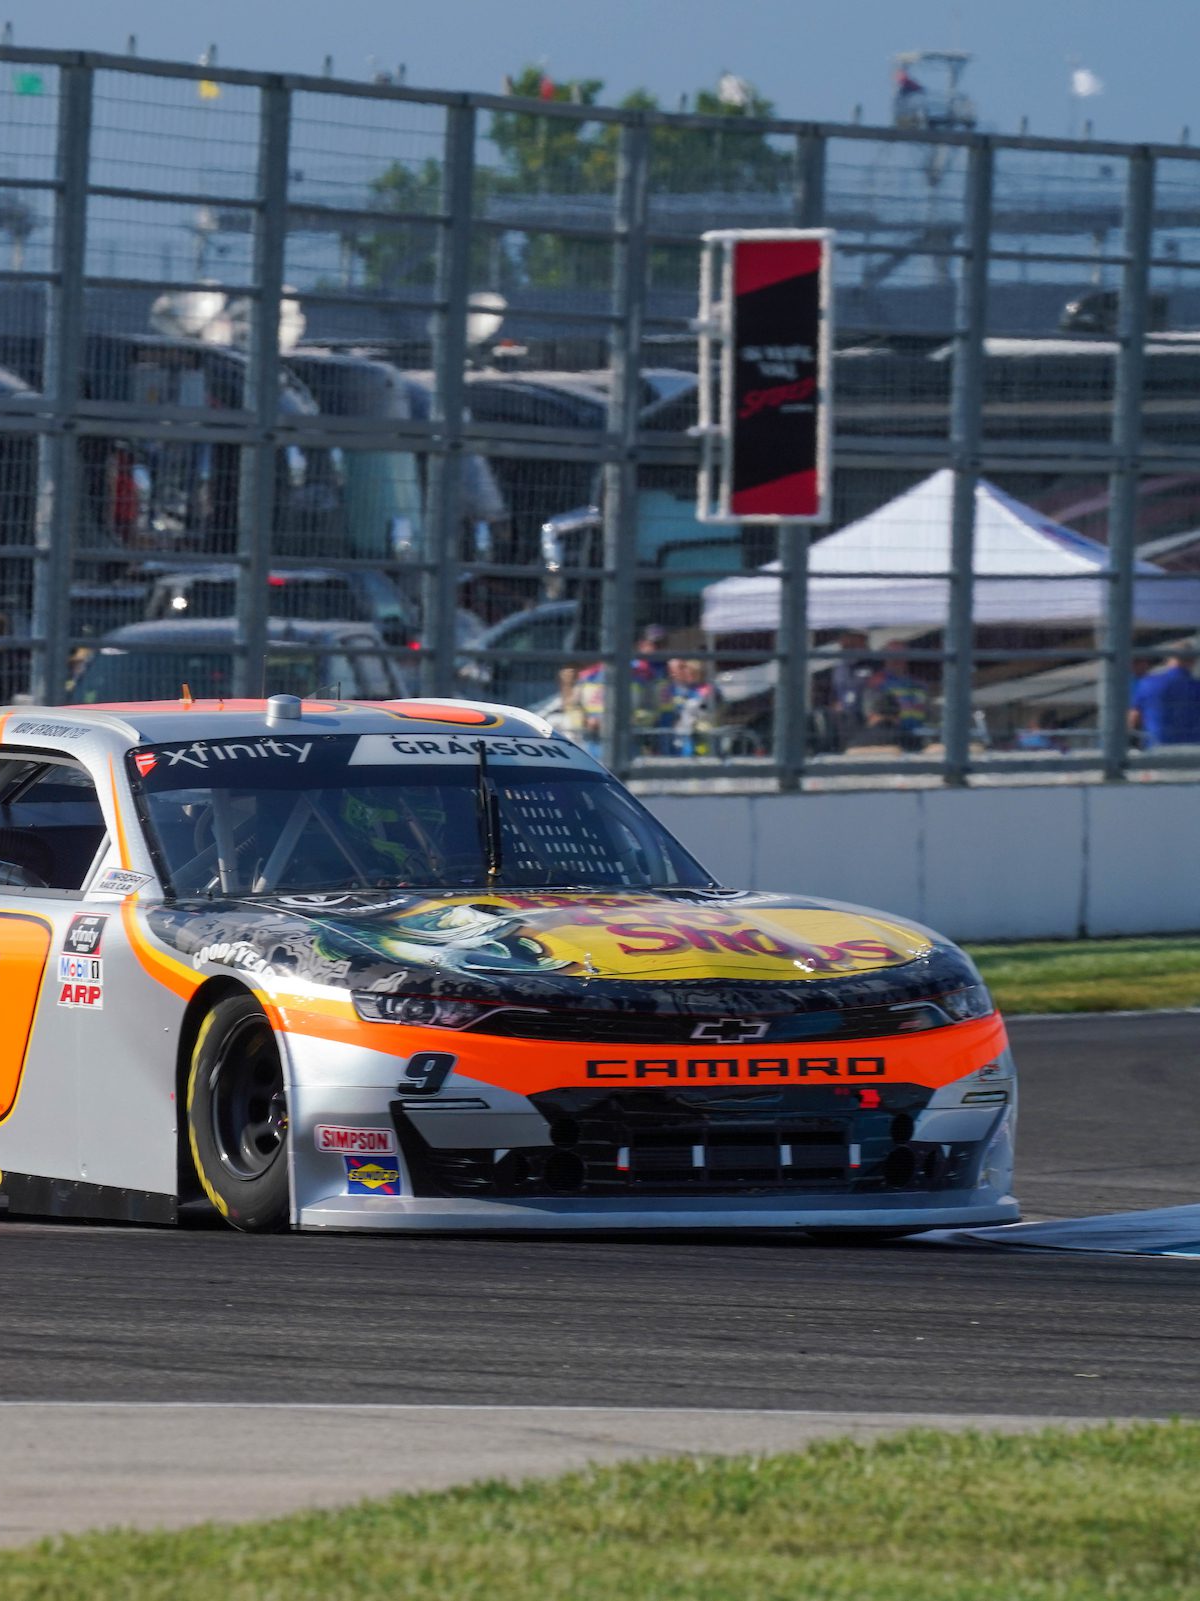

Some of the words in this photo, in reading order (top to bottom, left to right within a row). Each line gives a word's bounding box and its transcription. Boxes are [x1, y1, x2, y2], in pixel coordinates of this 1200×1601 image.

[162, 741, 313, 769] xfinity
[392, 740, 571, 760] GRAGSON
[61, 957, 89, 978] Mobil
[91, 960, 99, 979] 1
[60, 983, 101, 1005] ARP
[397, 1051, 458, 1097] 9
[586, 1056, 885, 1079] CAMARO
[322, 1129, 389, 1150] SIMPSON
[350, 1169, 399, 1182] SUNOCO
